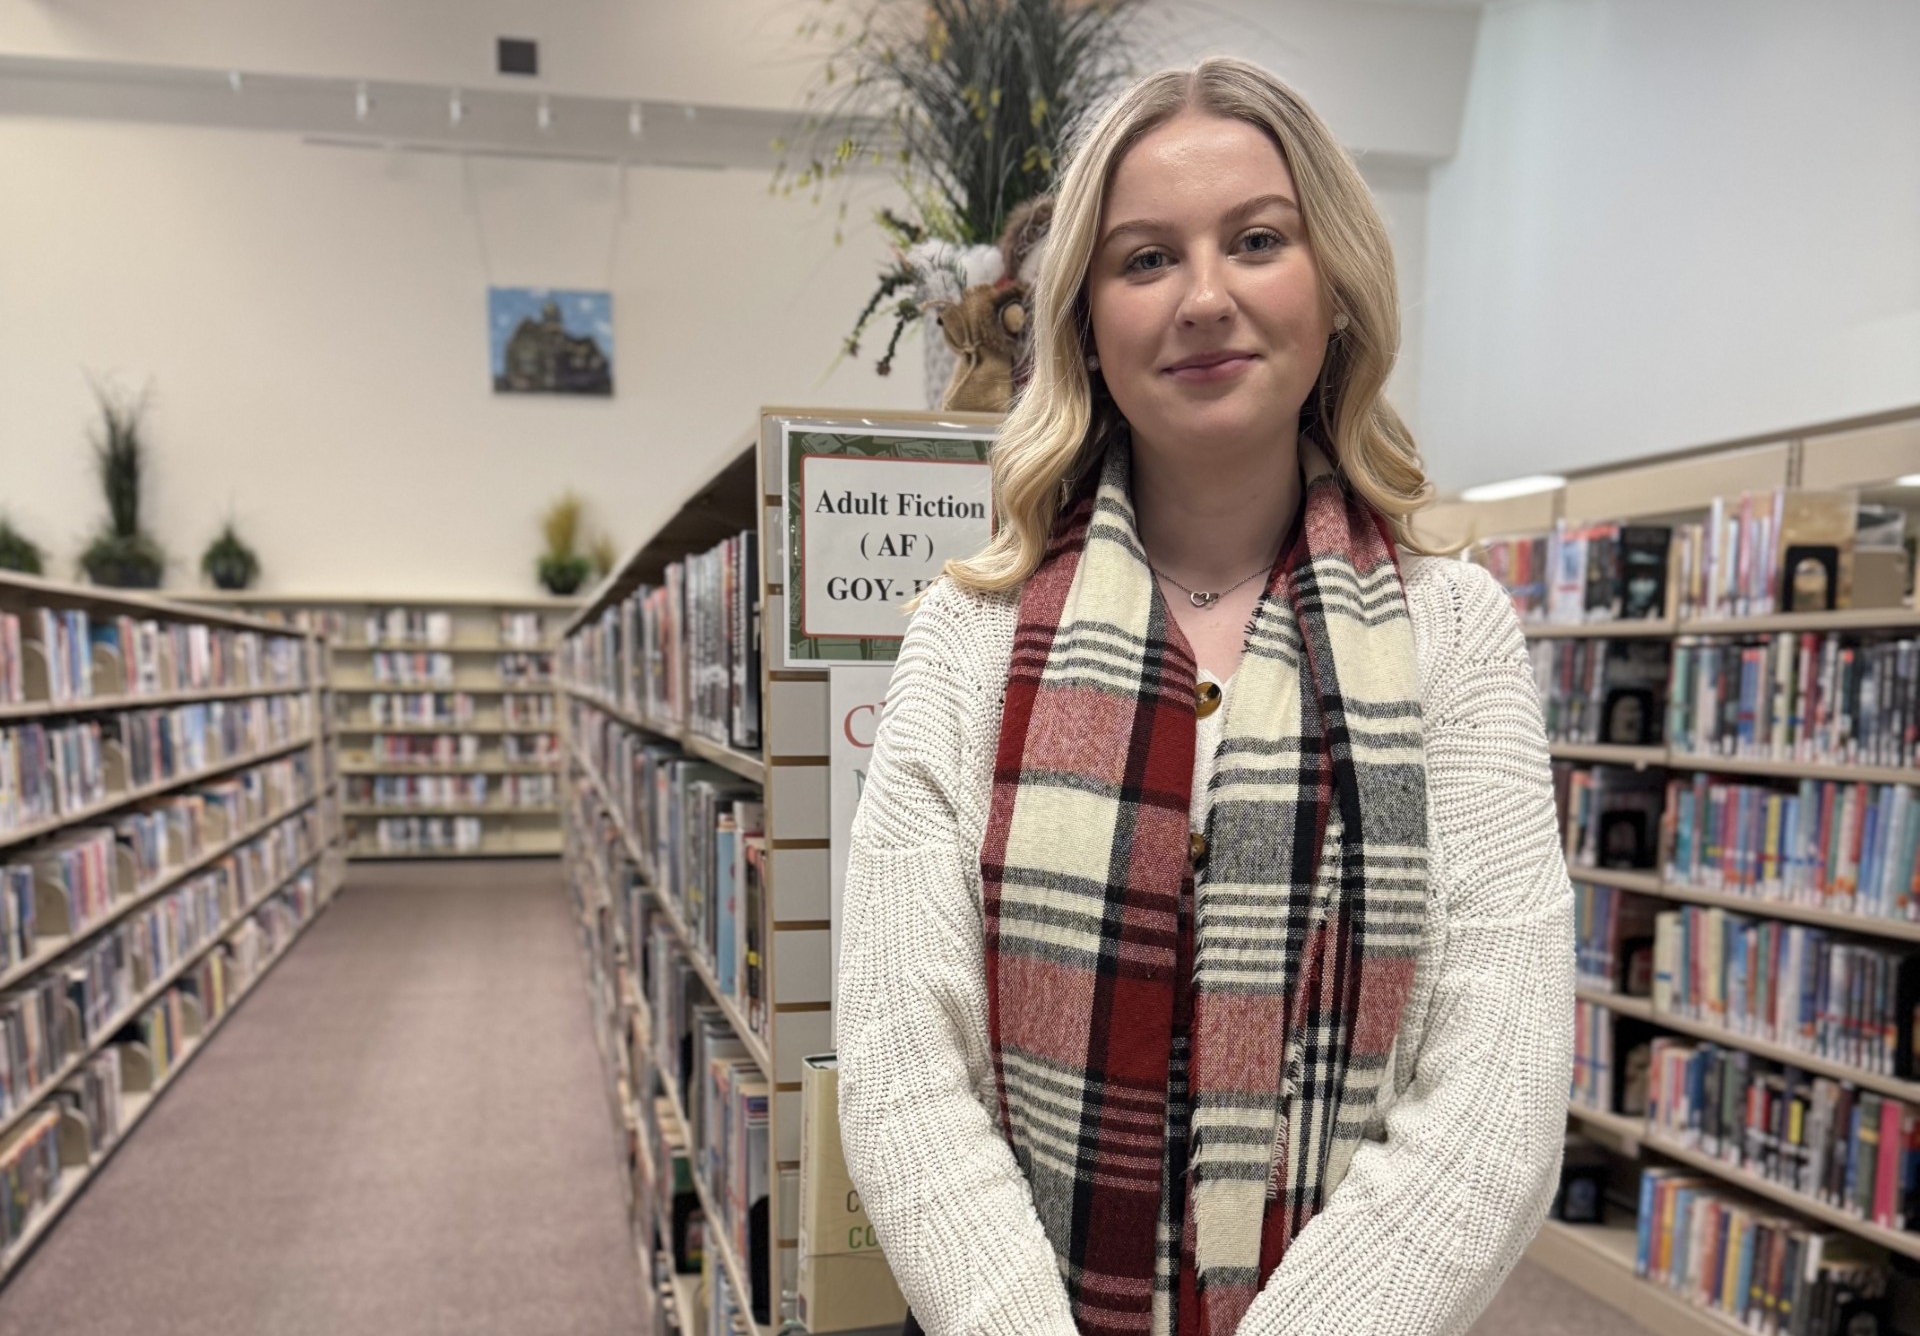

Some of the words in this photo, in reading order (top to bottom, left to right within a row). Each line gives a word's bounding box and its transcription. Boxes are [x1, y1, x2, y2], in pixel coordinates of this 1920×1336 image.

[815, 490, 889, 515] Adult
[897, 493, 986, 518] Fiction
[827, 577, 904, 601] GOY-
[844, 702, 887, 748] C
